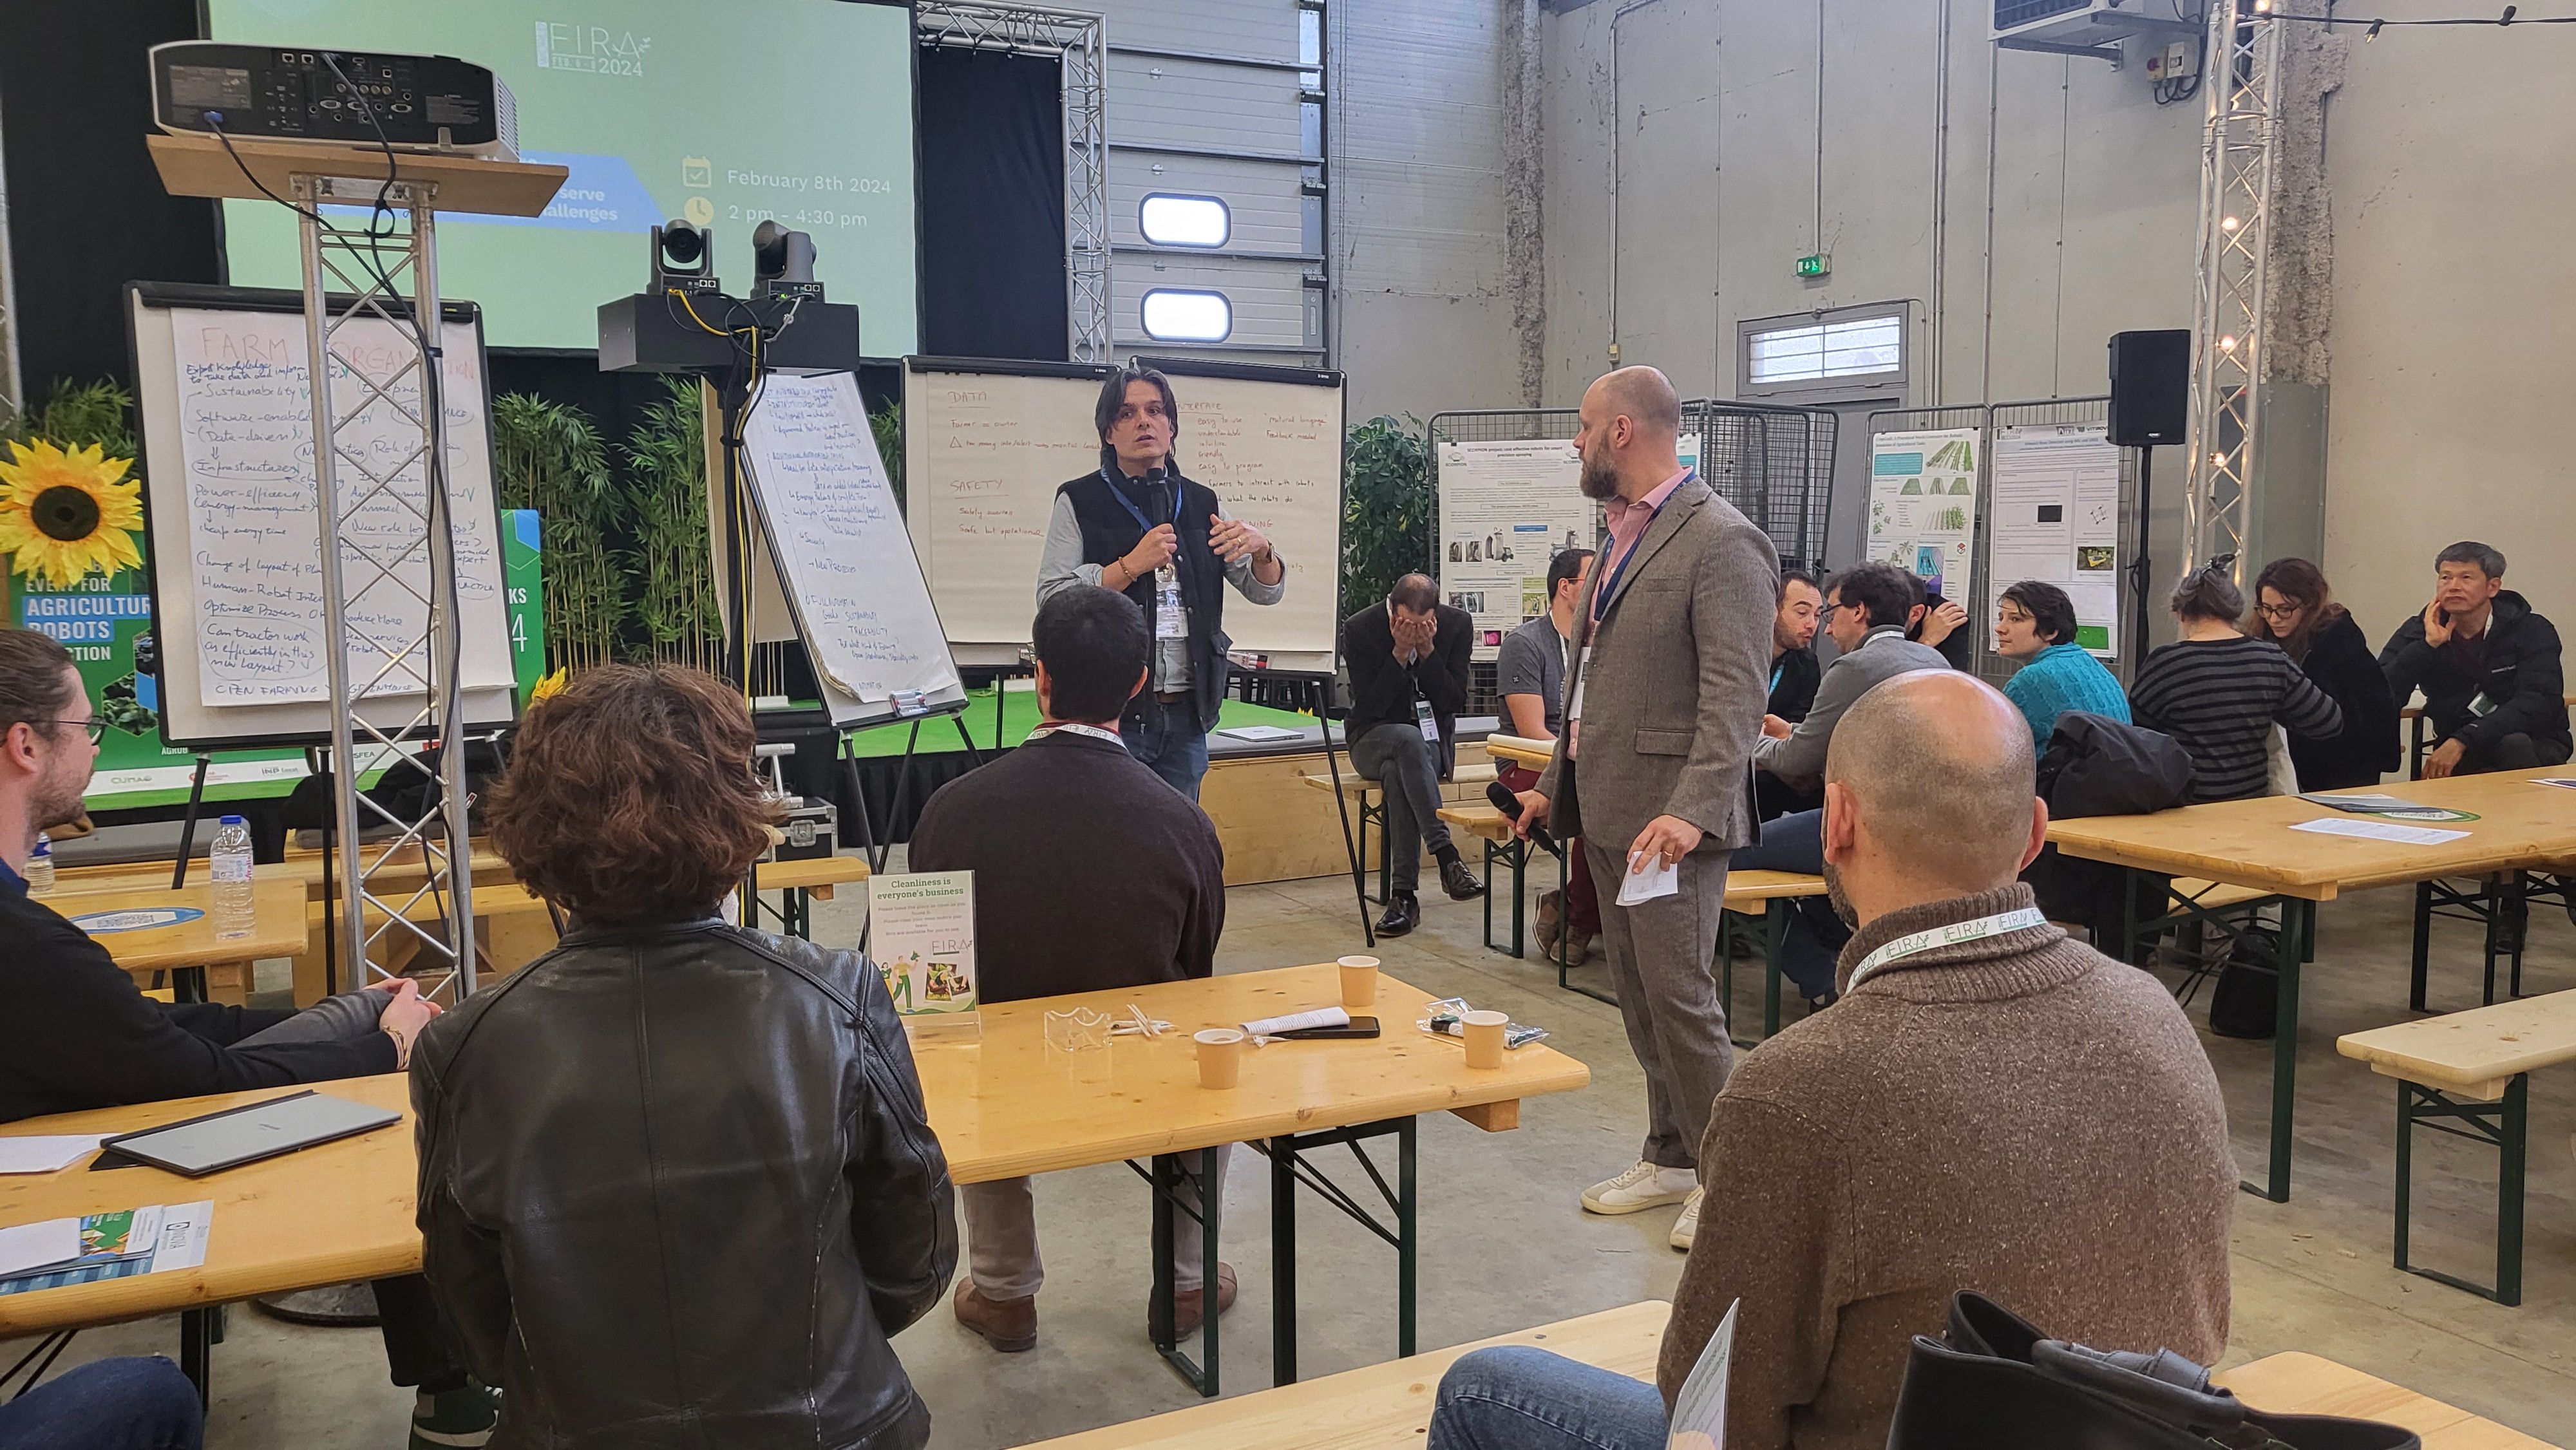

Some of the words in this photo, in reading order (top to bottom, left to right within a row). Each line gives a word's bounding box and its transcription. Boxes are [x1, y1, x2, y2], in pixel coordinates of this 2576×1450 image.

[550, 23, 641, 60] FIRA
[598, 58, 644, 77] 2024
[728, 169, 808, 192] February
[814, 175, 843, 191] 8th
[849, 178, 892, 193] 2024
[559, 187, 605, 202] serve
[544, 203, 618, 223] allenges
[728, 205, 739, 220] 2
[746, 209, 774, 223] pm
[796, 209, 834, 225] 4:30
[840, 214, 867, 229] pm
[202, 327, 290, 363] FARM
[947, 391, 988, 404] DATA
[1177, 402, 1223, 411] NTERFACE
[1197, 418, 1217, 429] easy
[1198, 463, 1217, 475] easy
[949, 479, 1003, 493] SAFETY
[1208, 479, 1233, 487] farmers
[958, 523, 979, 534] Safe
[985, 526, 996, 534] but
[80, 577, 112, 592] FOR
[65, 645, 112, 662] CTION
[891, 878, 942, 889] Cleanliness
[943, 877, 951, 885] is
[877, 889, 923, 900] everyone's
[925, 887, 964, 897] business
[1946, 919, 1986, 942] FIRA
[931, 939, 970, 953] FIRA
[1886, 932, 1927, 958] FIRA
